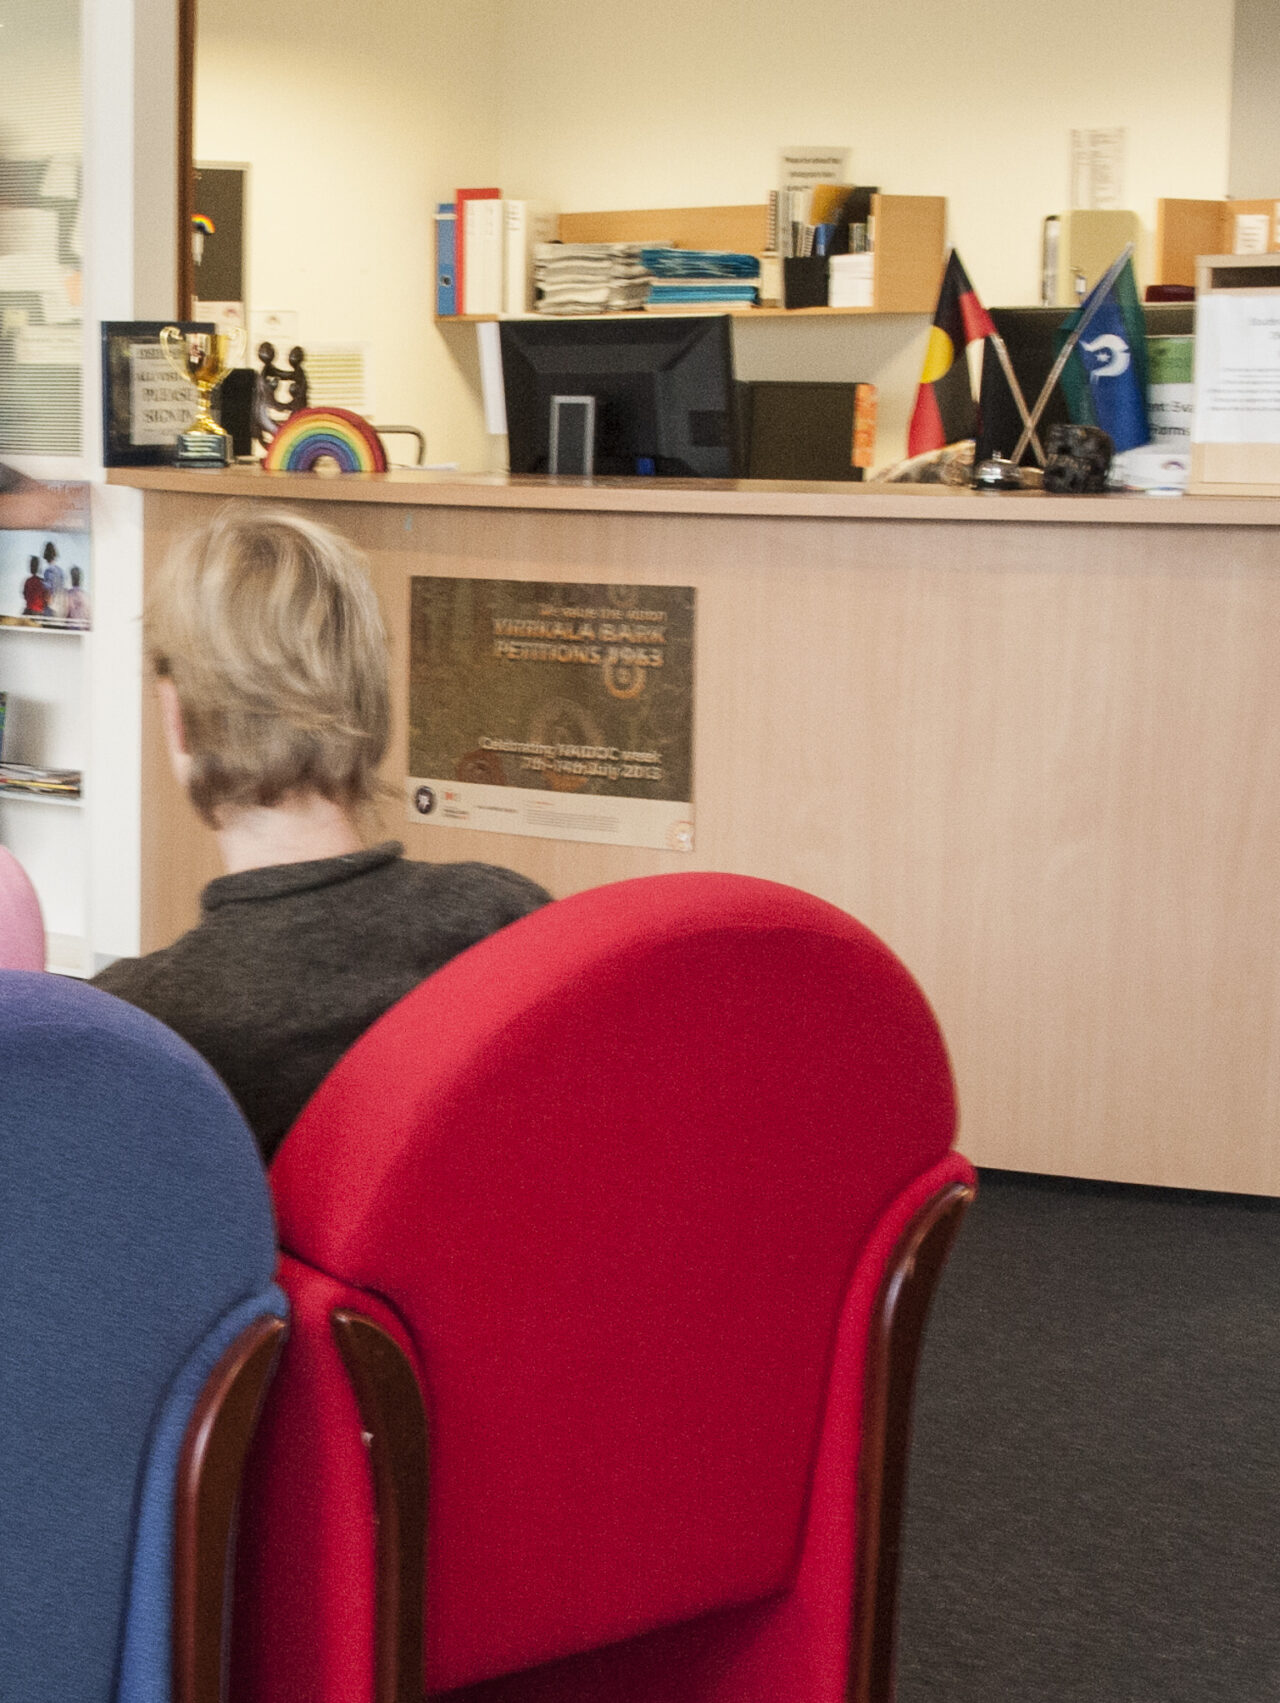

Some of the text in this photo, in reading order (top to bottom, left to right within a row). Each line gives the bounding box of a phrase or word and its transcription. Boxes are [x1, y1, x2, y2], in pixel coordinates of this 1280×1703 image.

[143, 388, 194, 402] PLEASE
[143, 409, 175, 423] SIGN
[599, 623, 666, 644] BARK
[494, 640, 664, 667] PETITIONS 1963
[478, 736, 556, 759] Celebrating
[620, 750, 663, 764] week
